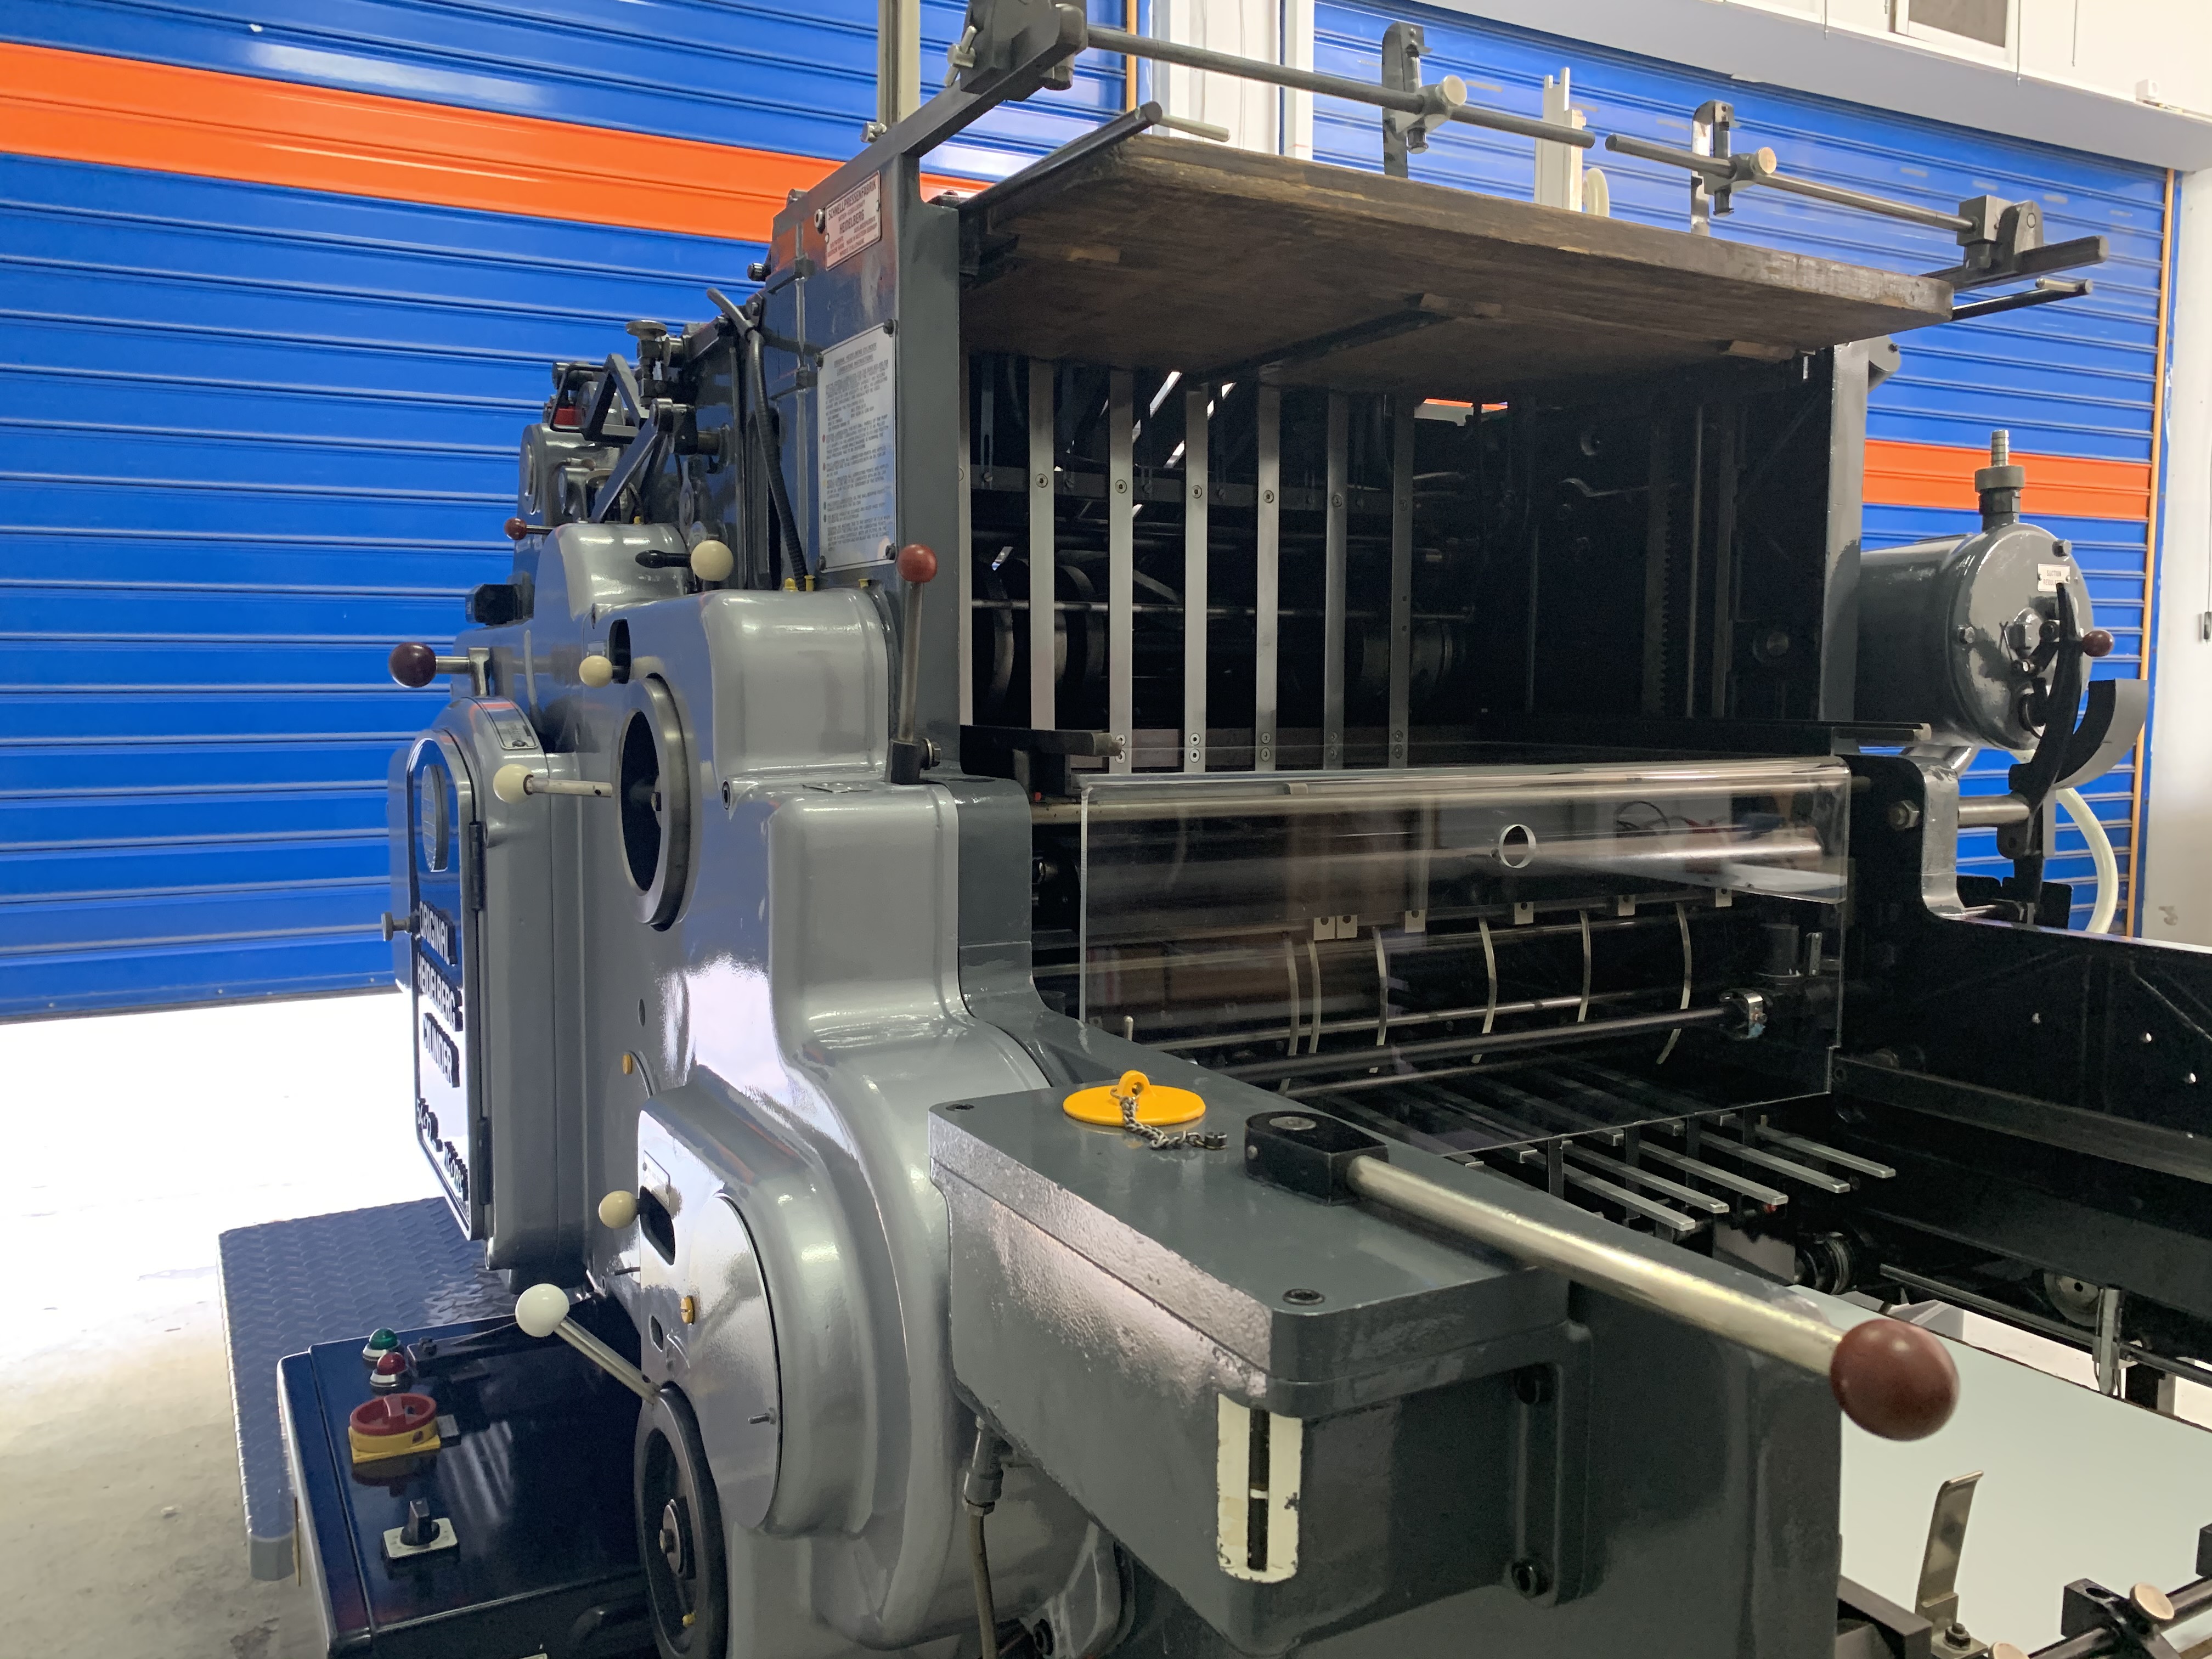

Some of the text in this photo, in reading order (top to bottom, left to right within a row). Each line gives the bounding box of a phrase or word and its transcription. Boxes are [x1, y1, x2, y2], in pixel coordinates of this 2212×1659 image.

[839, 209, 864, 235] HEIDELBERG
[419, 901, 450, 966] ORIGINAL
[417, 951, 456, 1032] HEIDELBERG
[422, 1015, 454, 1085] CYLINDER
